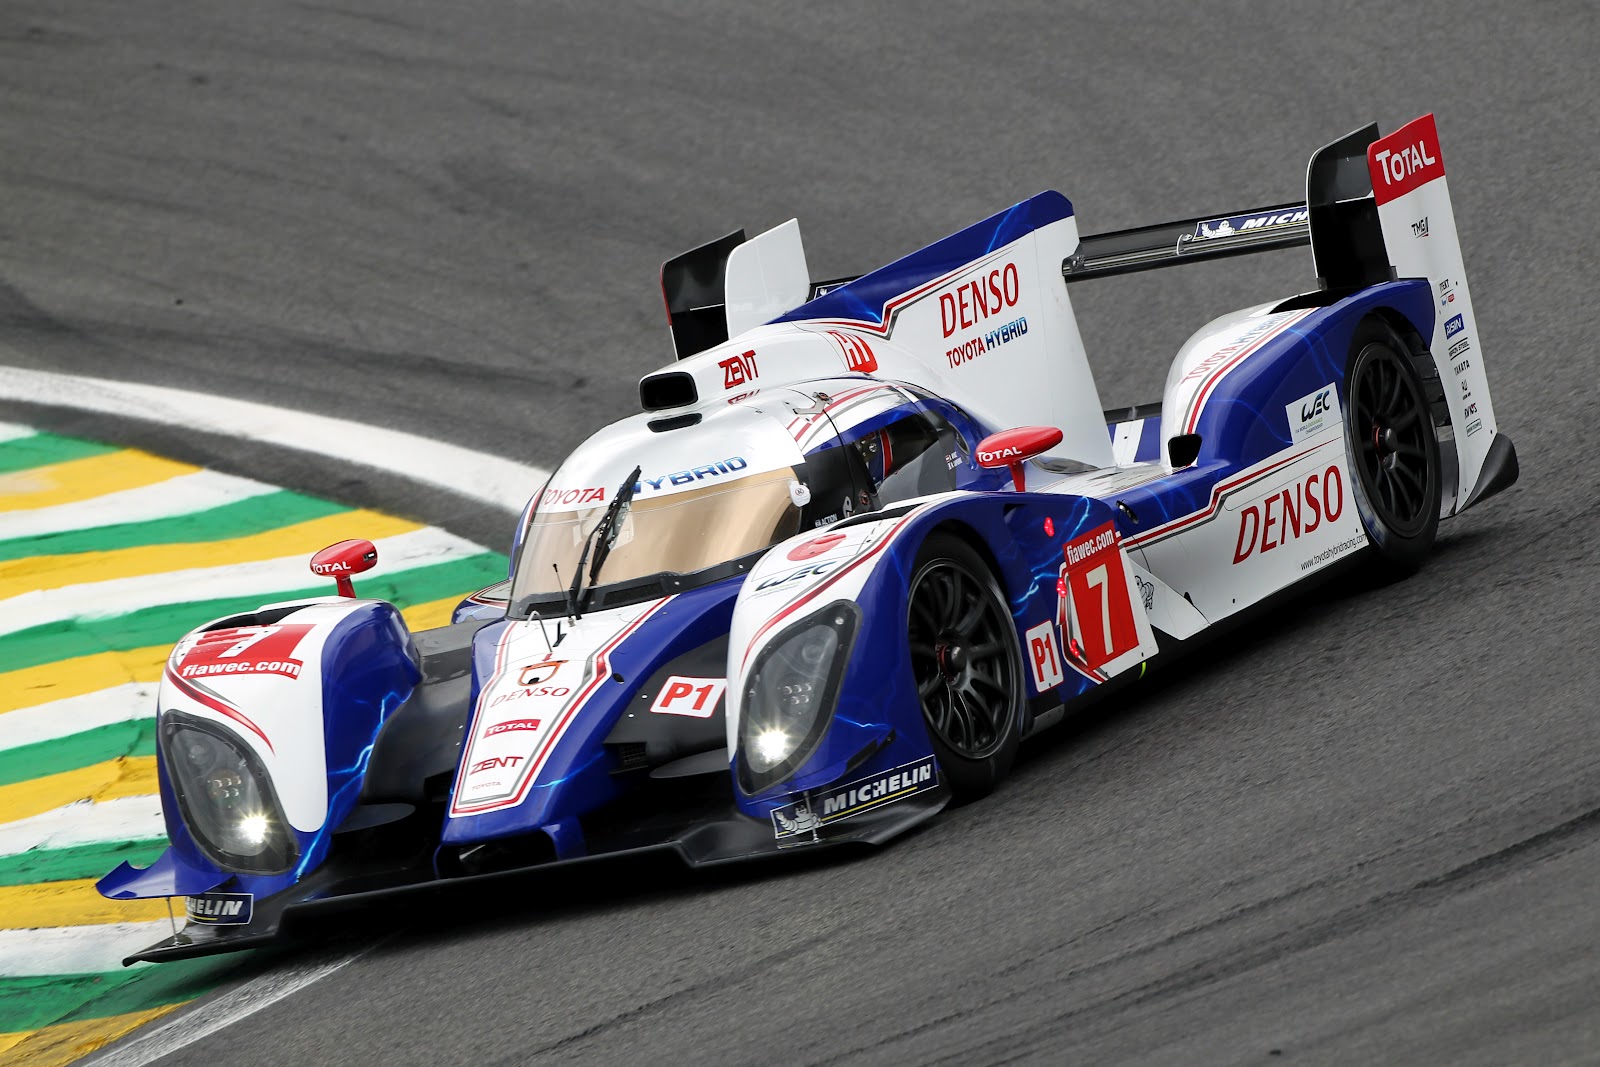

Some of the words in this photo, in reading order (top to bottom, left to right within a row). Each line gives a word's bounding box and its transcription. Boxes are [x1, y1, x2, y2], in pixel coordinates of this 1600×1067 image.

[1375, 140, 1436, 186] TOTAL
[939, 263, 1019, 338] DENSO
[946, 337, 986, 369] TOYOTA
[985, 317, 1028, 351] HYBRID
[718, 350, 759, 390] ZENT
[1301, 390, 1330, 422] WEC
[978, 447, 1022, 462] TOTAL
[542, 487, 605, 505] TOYOTA
[1232, 465, 1343, 565] DENSO
[1066, 529, 1115, 566] fiawec.com
[1300, 534, 1367, 571] www.toyotahybridracing.com
[312, 561, 351, 574] TOTAL
[755, 561, 837, 591] WEC
[1085, 563, 1114, 656] 7
[181, 661, 301, 677] fiawec.com
[1031, 633, 1058, 683] P1
[490, 687, 570, 708] DENSO
[659, 682, 714, 711] P1
[488, 722, 537, 735] TOTAL
[469, 756, 524, 776] ZENT
[824, 764, 932, 815] MICHELIN
